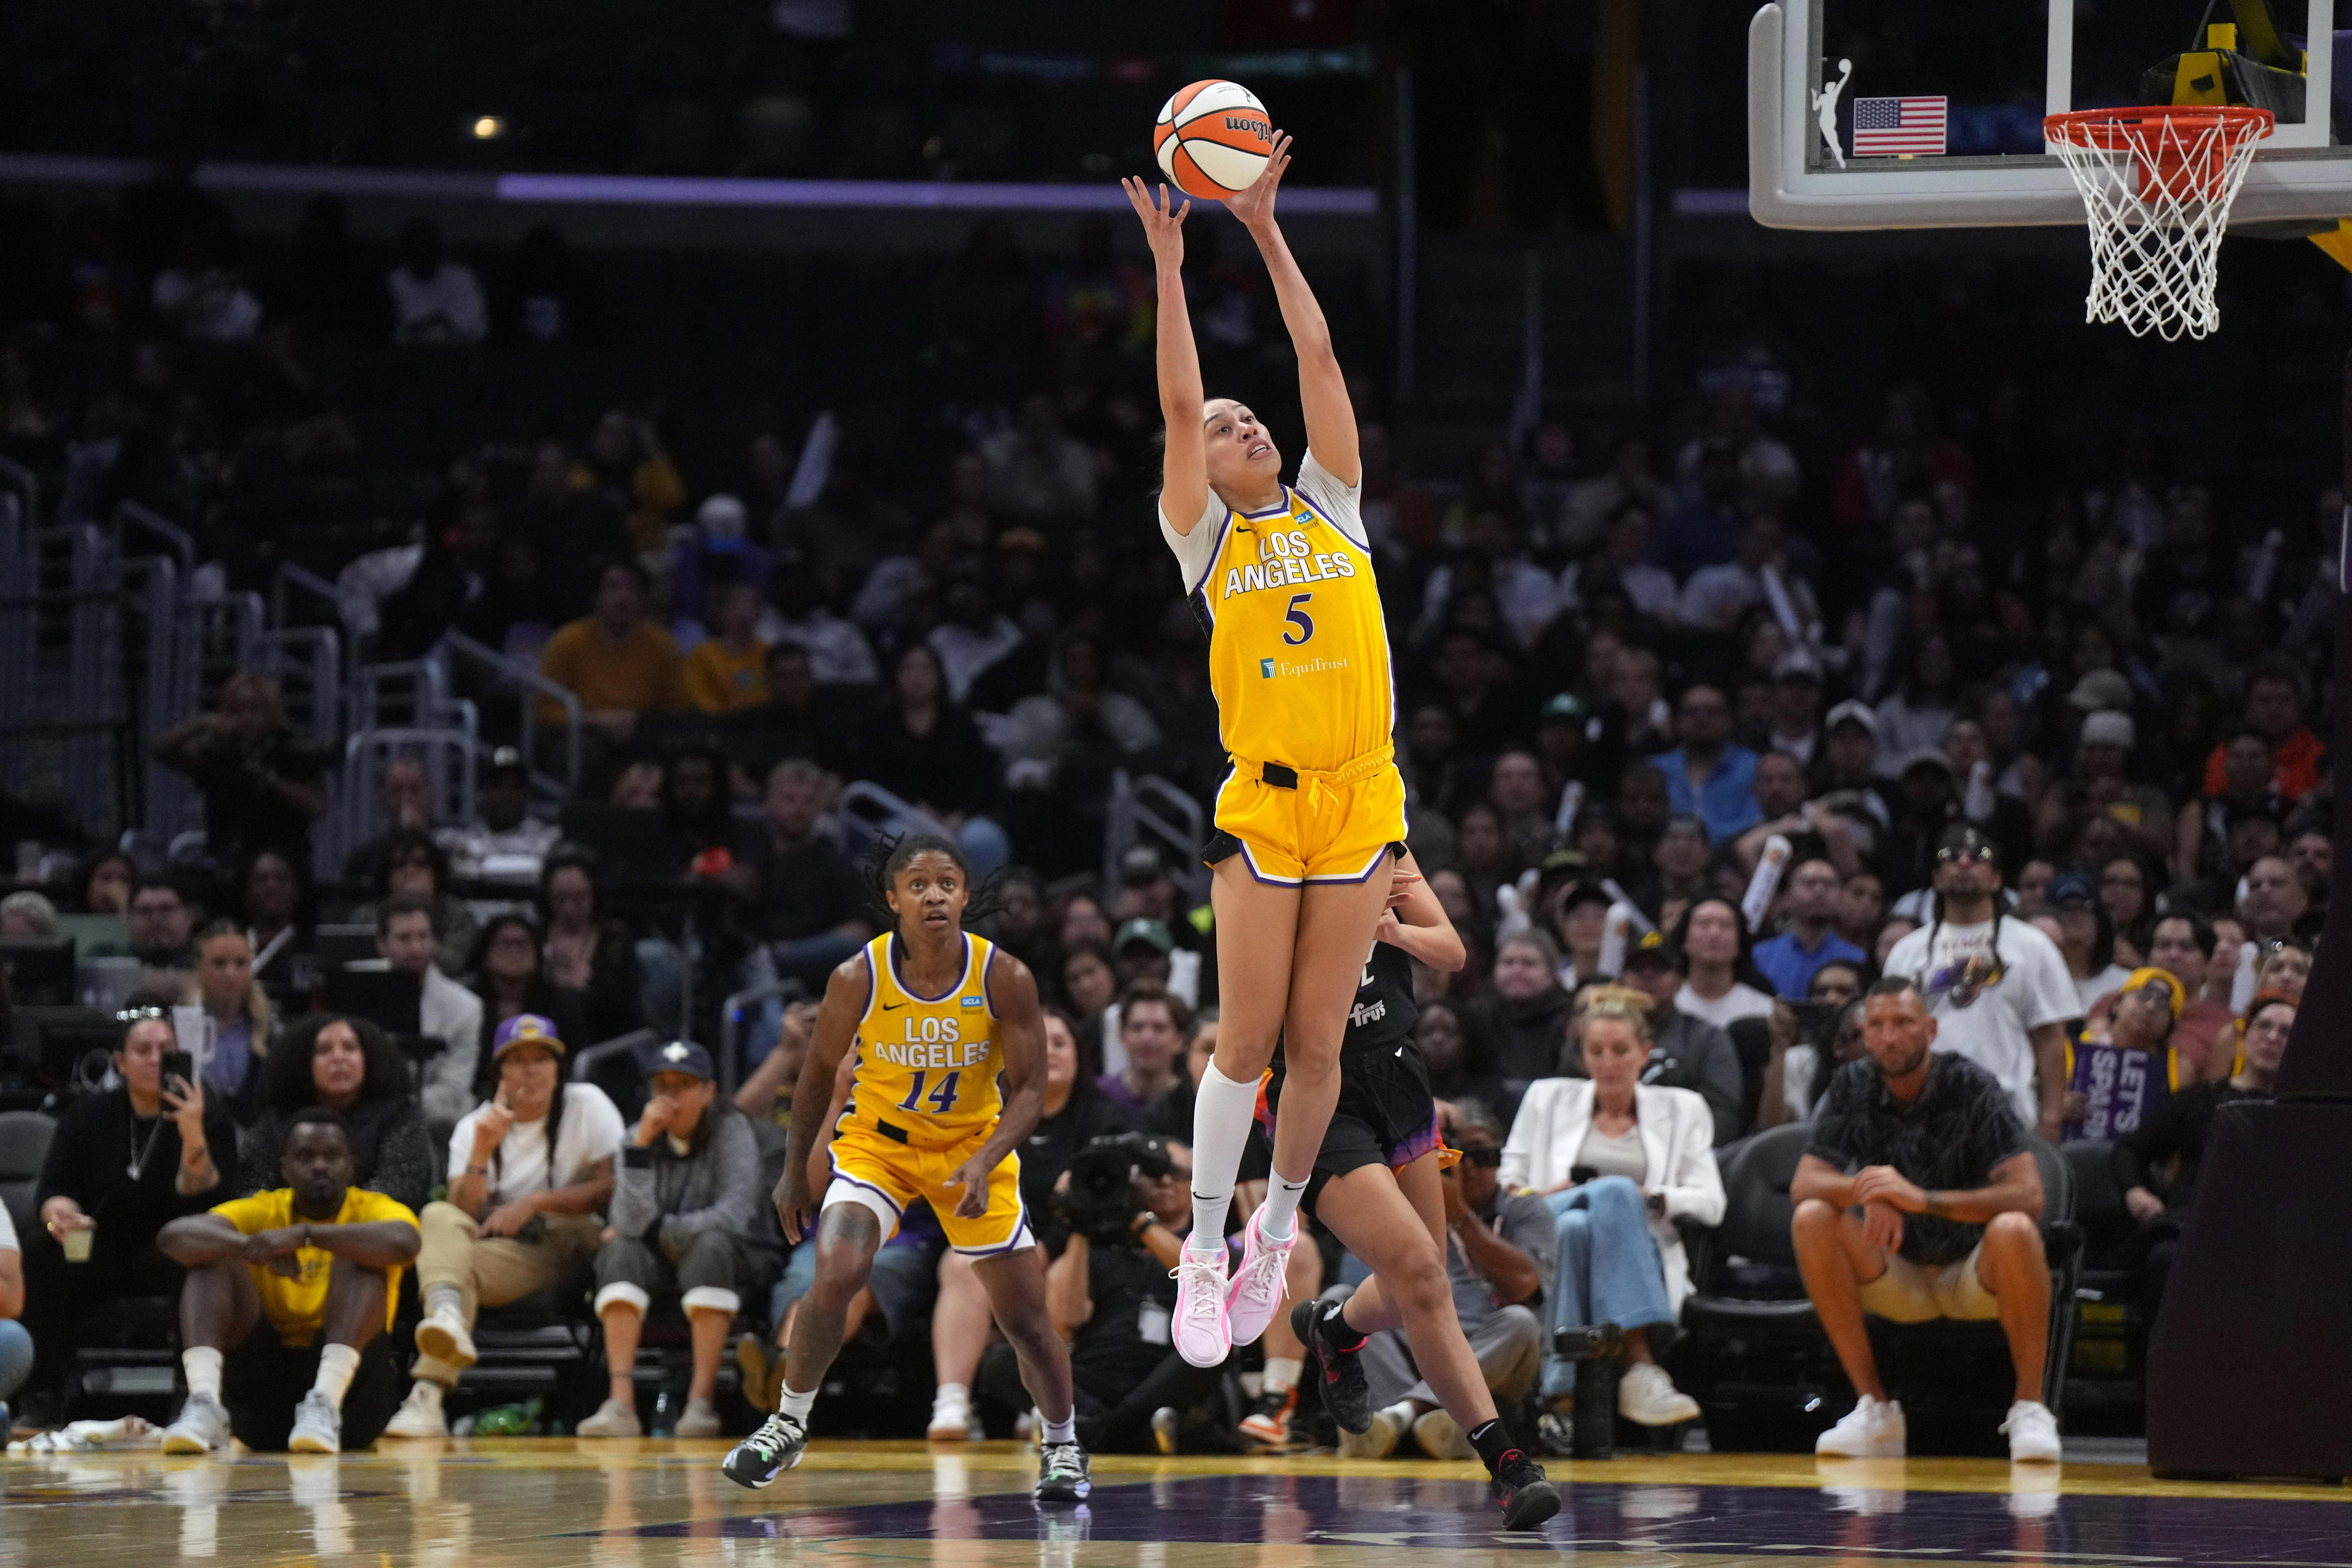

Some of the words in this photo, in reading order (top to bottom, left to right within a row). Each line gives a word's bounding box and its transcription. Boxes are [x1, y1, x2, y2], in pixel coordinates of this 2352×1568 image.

[1302, 521, 1319, 531] ealth
[1259, 531, 1311, 564] LOS
[1224, 552, 1355, 600] ANGELES
[1282, 592, 1314, 645] 5
[1281, 657, 1348, 677] EquiTrust
[905, 1017, 960, 1043] LOS
[875, 1040, 990, 1068] ANGELES
[896, 1070, 961, 1114] 14
